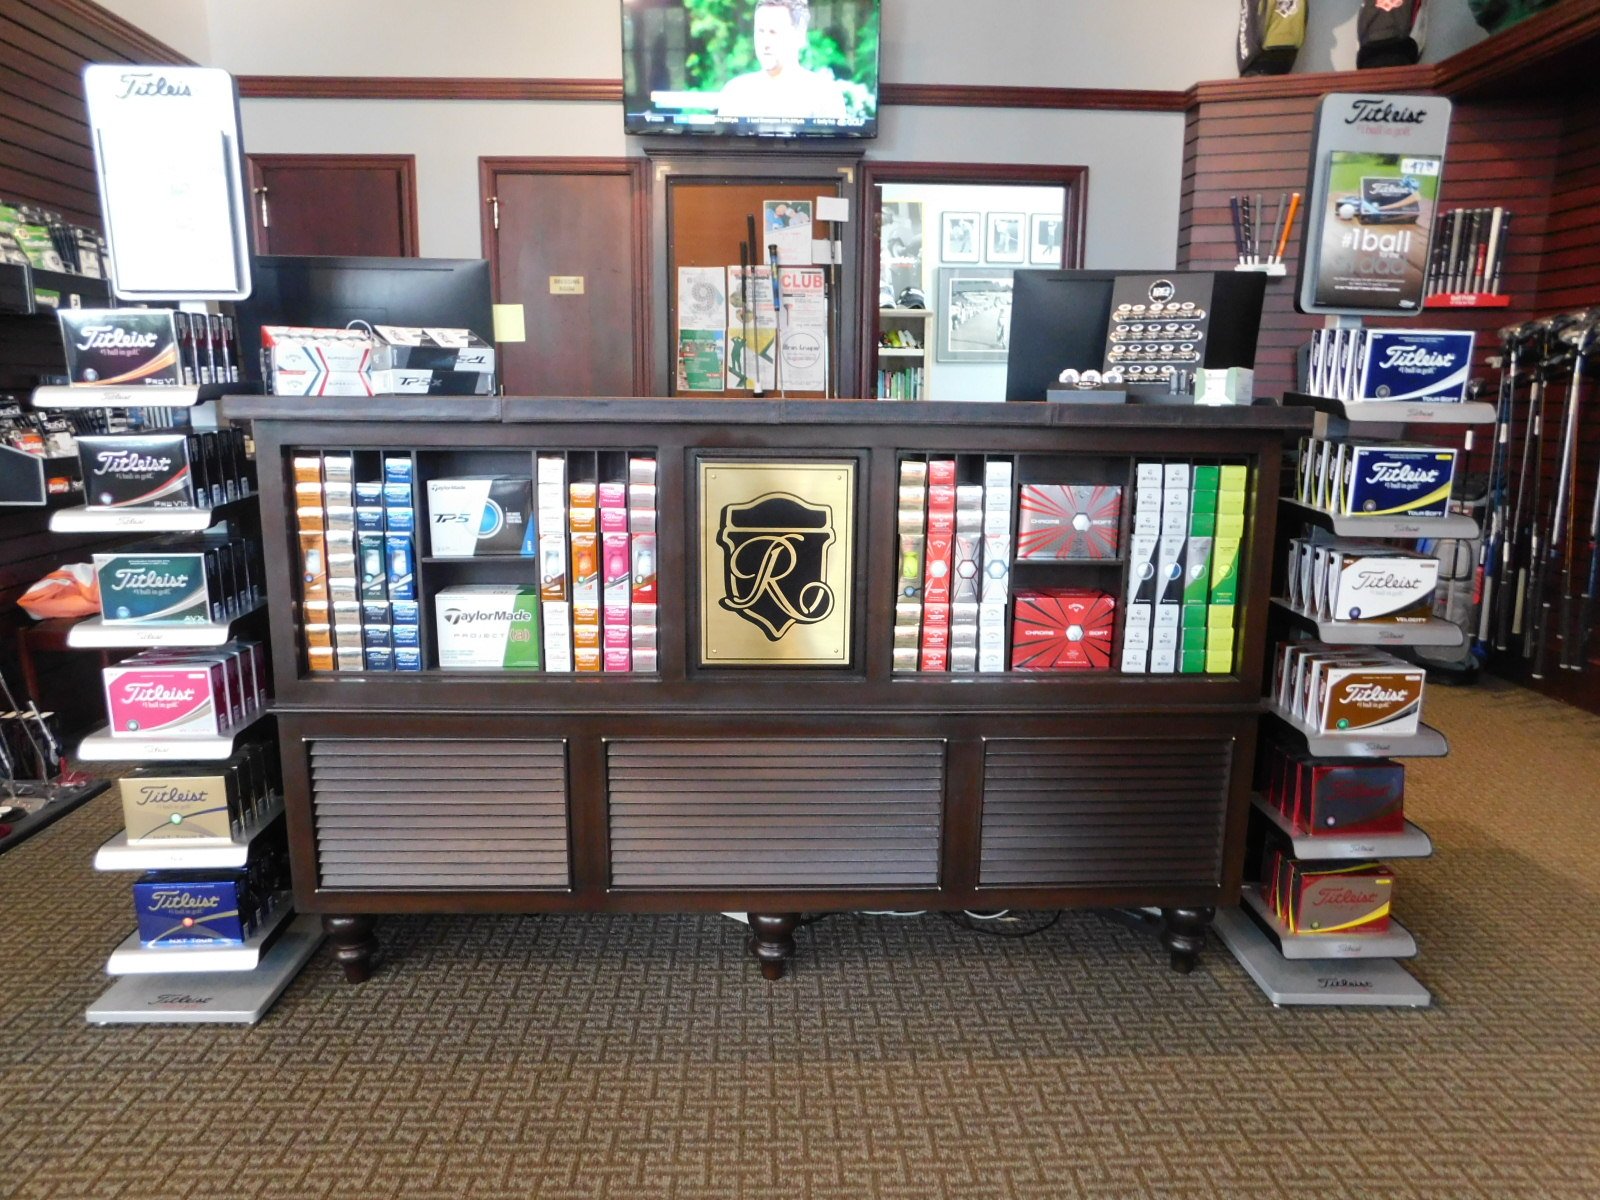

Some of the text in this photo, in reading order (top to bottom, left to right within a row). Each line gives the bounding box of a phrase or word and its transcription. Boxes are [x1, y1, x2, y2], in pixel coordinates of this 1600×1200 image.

[115, 74, 192, 99] Titleis
[1345, 99, 1428, 125] Titleist
[1361, 229, 1411, 253] ball
[781, 274, 823, 288] CLUB
[76, 326, 158, 350] Titleist
[1379, 345, 1457, 368] Titleist
[94, 450, 171, 475] Titleist
[1366, 462, 1438, 483] Titleist
[433, 513, 471, 523] TP5
[112, 568, 188, 590] Titleist
[1352, 571, 1421, 590] Titleist
[444, 608, 531, 625] TaylorMade
[122, 682, 195, 704] Titleist
[1339, 683, 1408, 703] Titleist
[136, 785, 208, 805] Titleist
[148, 891, 220, 911] Titleist
[1313, 888, 1377, 906] Titleist
[1318, 977, 1373, 988] Titleist
